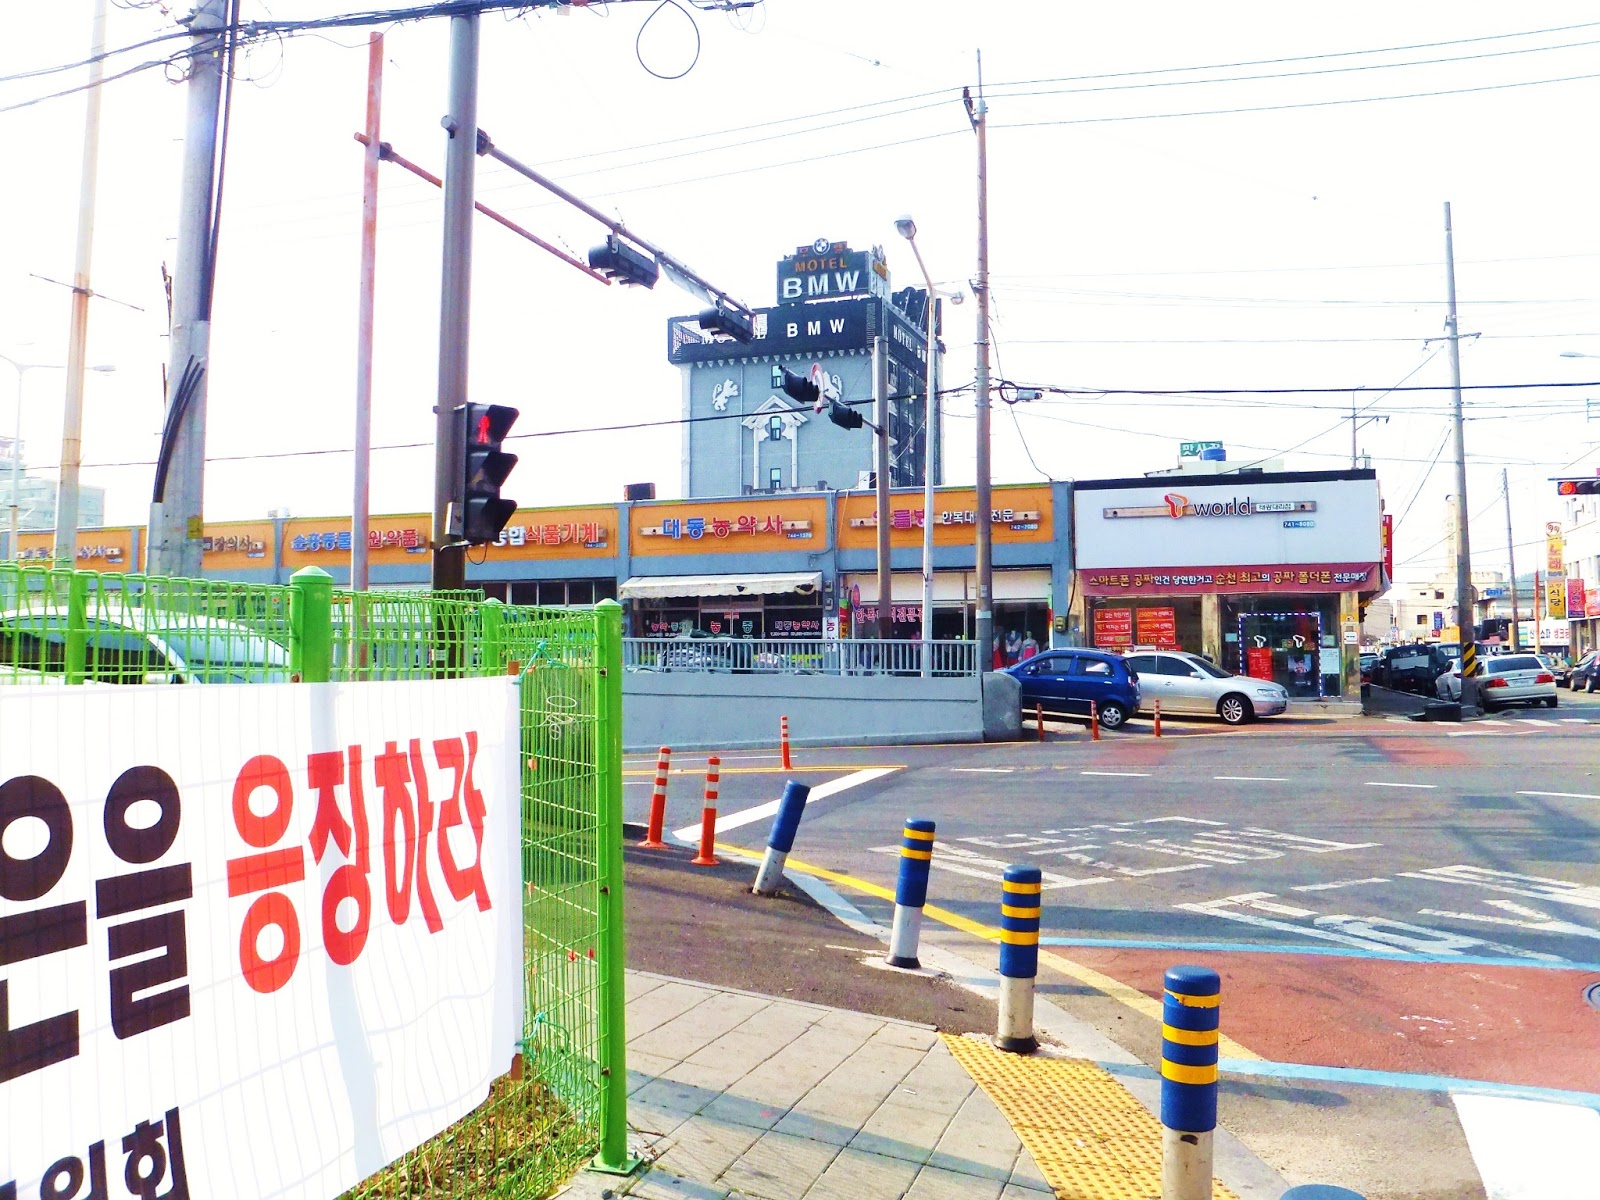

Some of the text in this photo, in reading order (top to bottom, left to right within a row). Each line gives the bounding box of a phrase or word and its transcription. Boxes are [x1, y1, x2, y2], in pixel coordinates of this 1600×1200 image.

[795, 257, 848, 273] MOTEL
[783, 270, 860, 299] BMW
[786, 318, 845, 338] BMW
[893, 325, 913, 352] MOTEL
[941, 508, 1014, 525] 한복대전문
[1193, 496, 1252, 517] world
[662, 514, 783, 540] 대동농약사
[1089, 574, 1130, 587] 스마트폰
[1134, 573, 1170, 587] 공짜인건
[1172, 575, 1213, 586] 당연한거고
[1215, 572, 1237, 585] 순천
[1239, 571, 1270, 584] 최고의
[1273, 571, 1295, 584] 공짜
[1333, 572, 1368, 583] 전문매장
[1549, 589, 1562, 606] 식당
[227, 731, 492, 994] 응징하라
